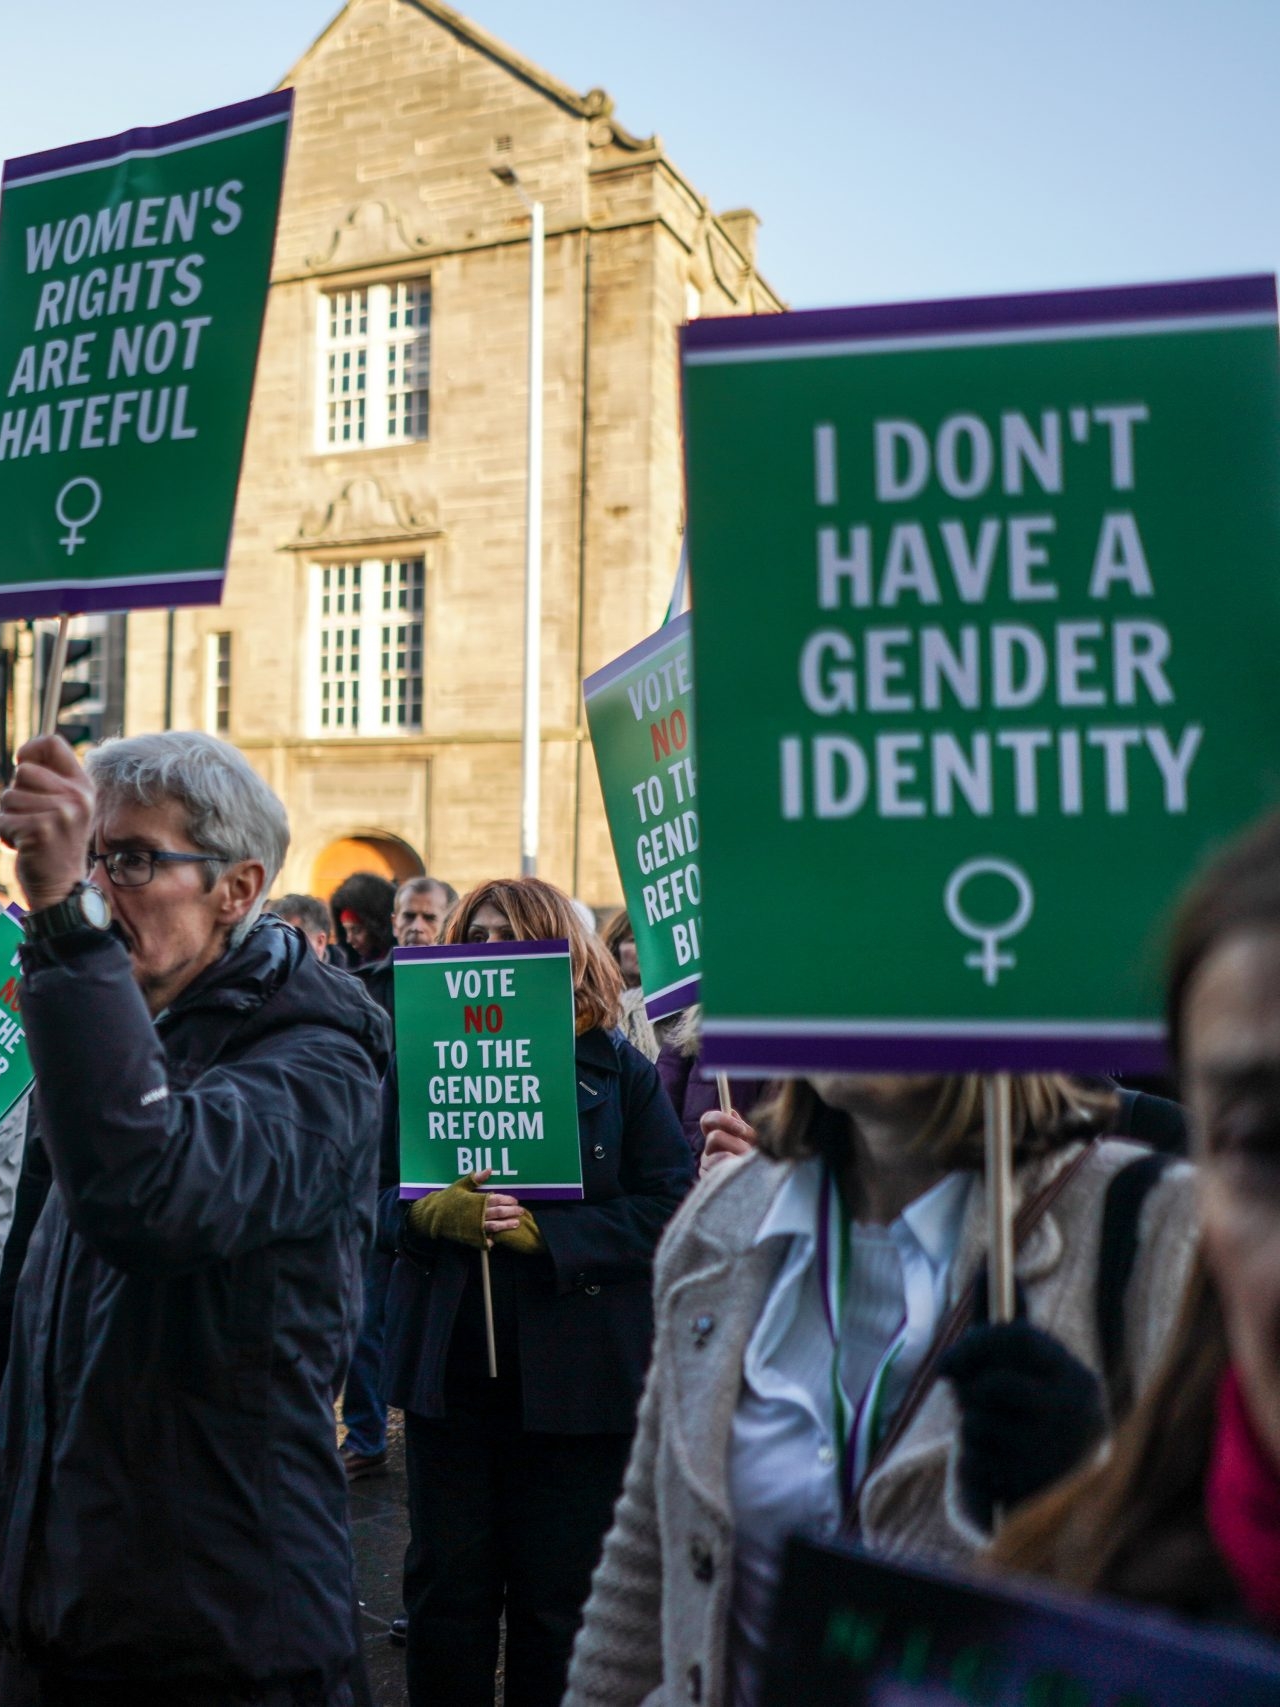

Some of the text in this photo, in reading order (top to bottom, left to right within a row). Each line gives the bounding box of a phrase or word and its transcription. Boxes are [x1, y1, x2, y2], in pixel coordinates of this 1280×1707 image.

[26, 179, 244, 274] WOMEN'S
[35, 253, 205, 332] RIGHTS
[7, 316, 212, 398] ARE NOT
[813, 404, 1149, 506] I DON'T
[816, 511, 1154, 611] HAVE A
[627, 653, 693, 721] VOTE
[799, 619, 1174, 715] GENDER
[650, 708, 688, 762] NO
[632, 757, 697, 823] TO TH
[780, 725, 1204, 820] IDENTITY
[637, 810, 700, 875] GEND
[642, 863, 701, 927] REFO
[672, 918, 702, 966] BI
[445, 968, 516, 999] VOTE
[464, 1004, 504, 1034] NO
[433, 1039, 532, 1070] TO THE
[428, 1075, 541, 1105] GENDER
[428, 1111, 544, 1140] REFORM
[457, 1146, 518, 1176] BILL
